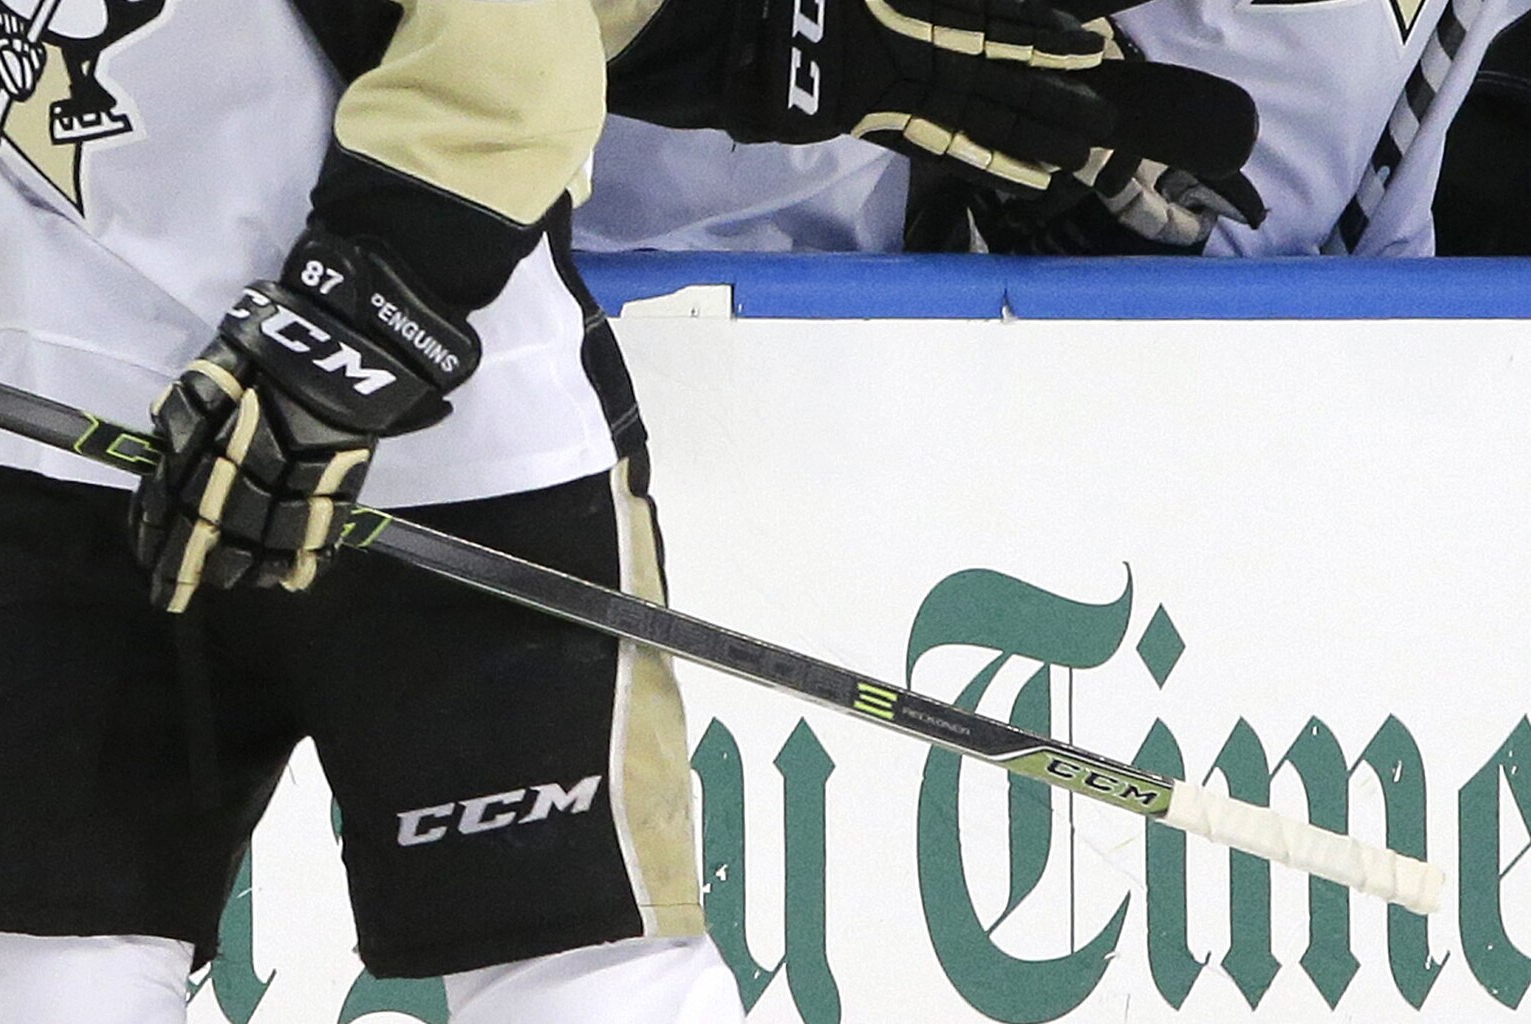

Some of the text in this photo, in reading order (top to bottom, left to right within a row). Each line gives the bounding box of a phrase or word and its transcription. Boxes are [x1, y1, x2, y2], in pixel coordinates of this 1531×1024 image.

[300, 259, 345, 295] 87
[370, 292, 461, 373] PENGUINS
[396, 775, 602, 847] CCM
[1045, 756, 1159, 806] CCM
